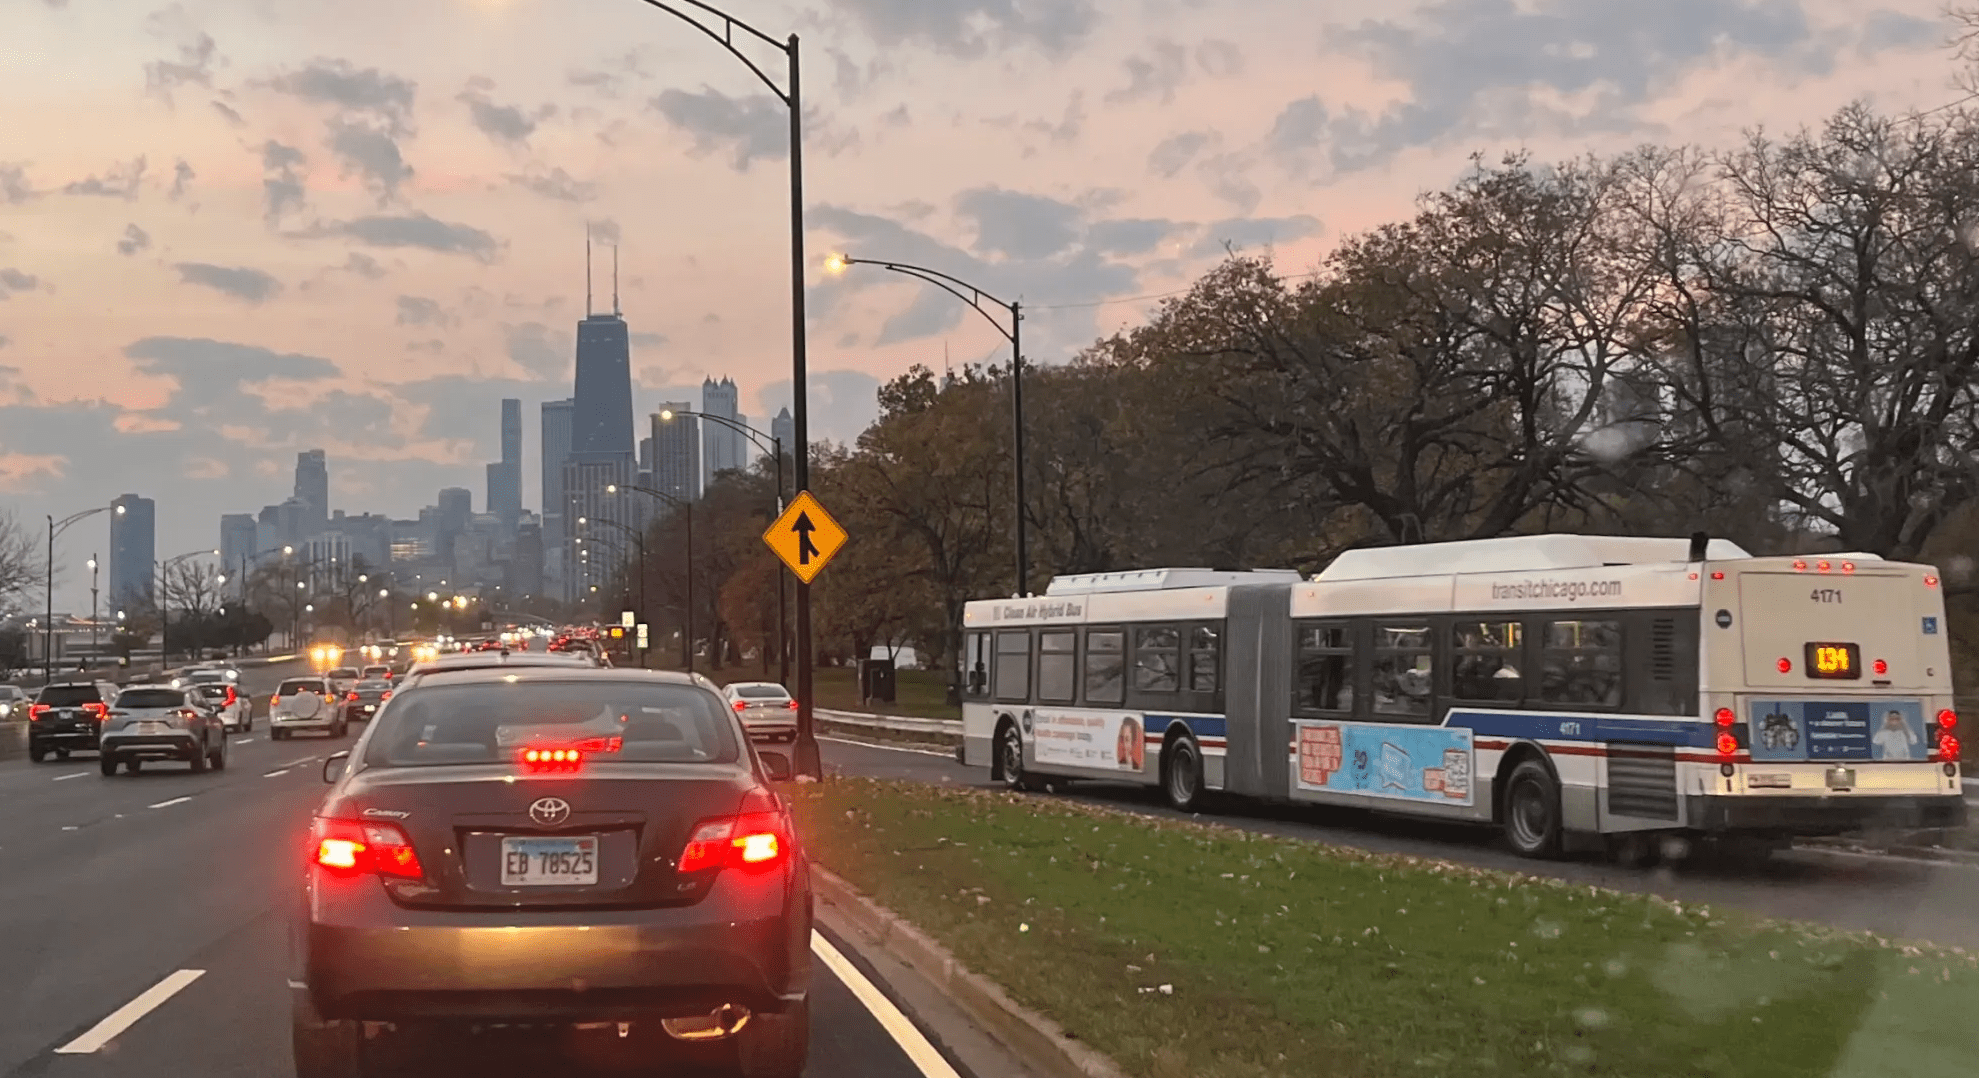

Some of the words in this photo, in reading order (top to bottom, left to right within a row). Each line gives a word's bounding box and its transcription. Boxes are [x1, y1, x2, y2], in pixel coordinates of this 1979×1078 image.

[1492, 578, 1621, 601] transitchicago.com
[1810, 588, 1842, 604] 4171
[1816, 647, 1849, 672] 134
[1560, 722, 1580, 735] 4171
[363, 808, 411, 819] Camry
[507, 852, 528, 874] EB
[539, 852, 593, 874] 78525
